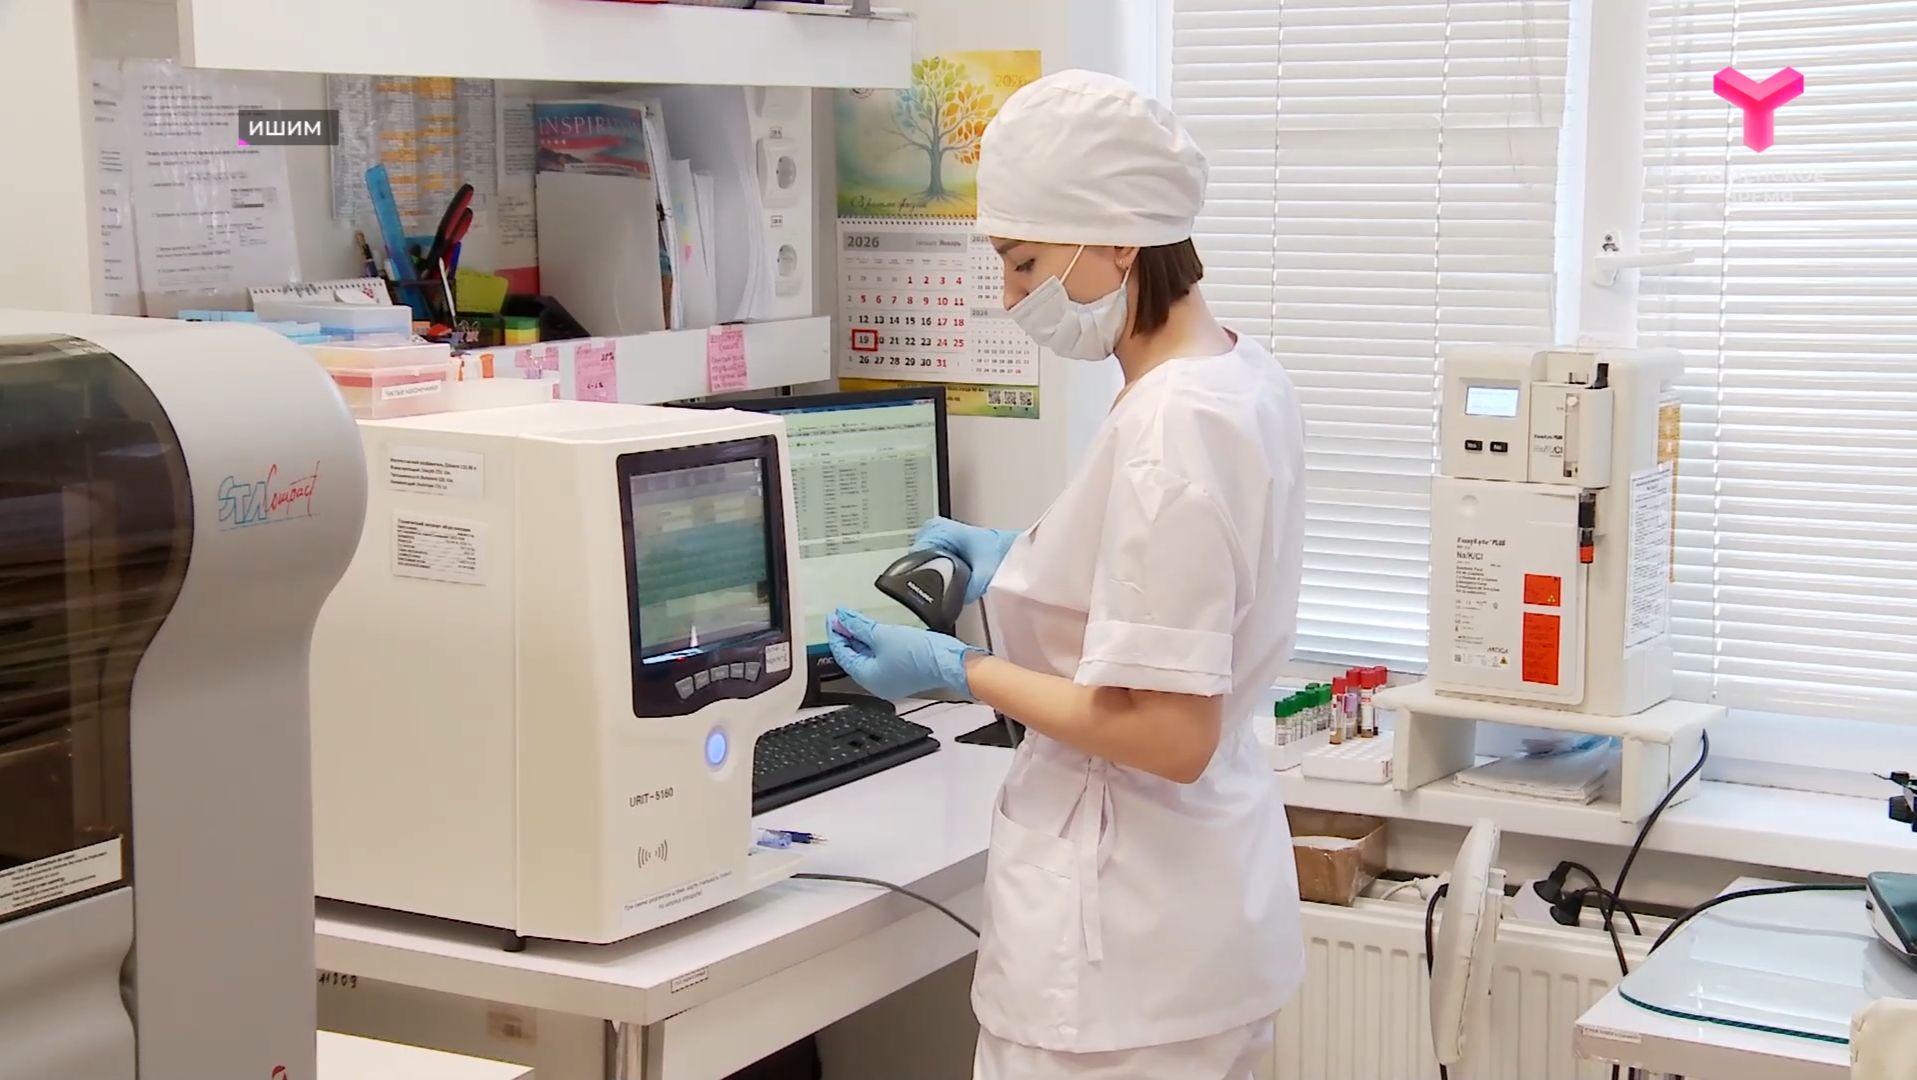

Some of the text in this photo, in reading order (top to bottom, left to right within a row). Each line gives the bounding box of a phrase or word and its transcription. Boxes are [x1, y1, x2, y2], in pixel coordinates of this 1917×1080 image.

[847, 235, 880, 248] 2026
[908, 276, 913, 284] 1
[923, 276, 929, 285] 2
[940, 276, 946, 285] 3
[955, 277, 962, 285] 4
[860, 294, 866, 304] 5
[875, 295, 882, 304] 6
[892, 295, 897, 305] 7
[906, 296, 914, 305] 8
[923, 296, 929, 305] 9
[937, 297, 949, 306] 10
[954, 297, 965, 306] 11
[859, 314, 965, 327] 12 13 14 15 16 17 18
[859, 336, 869, 344] 19
[889, 336, 899, 345] 21
[904, 336, 916, 346] 22
[920, 337, 932, 347] 23
[936, 338, 948, 347] 24
[953, 338, 964, 348] 25
[859, 355, 947, 368] 26 27 28 29 30 31
